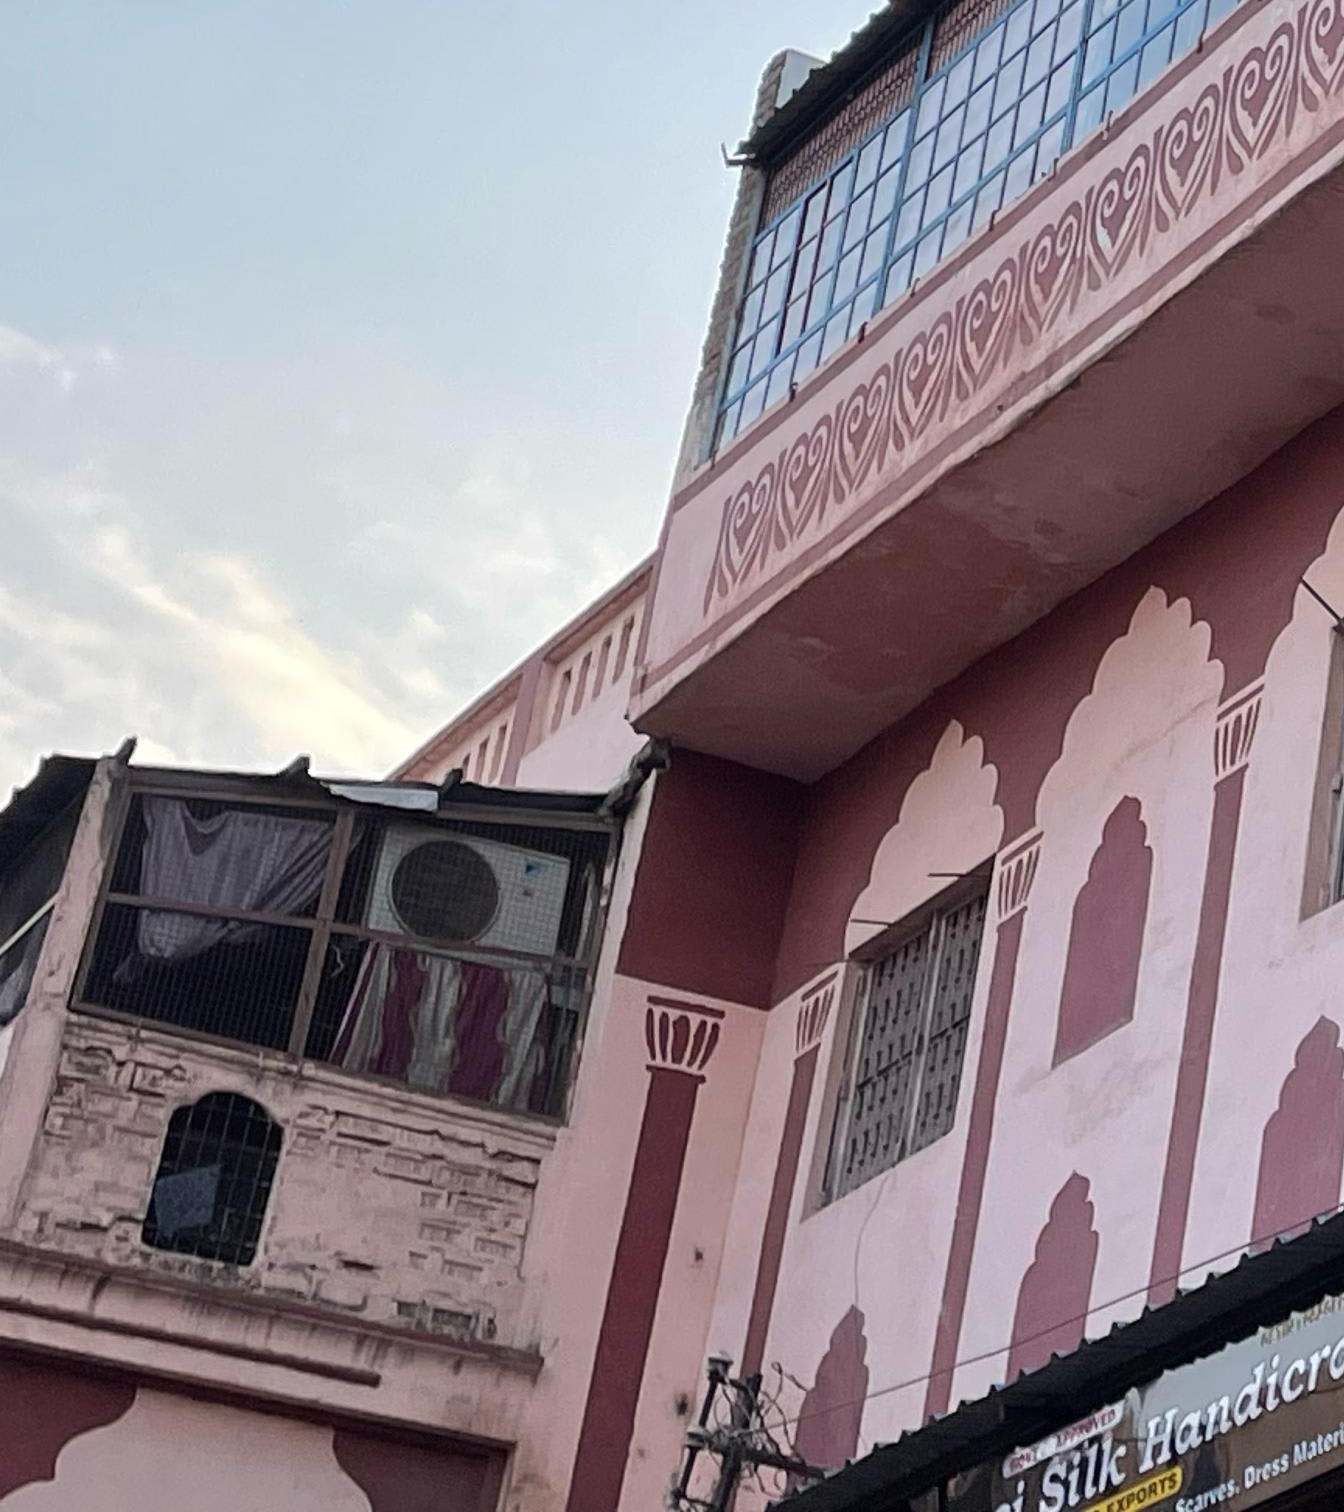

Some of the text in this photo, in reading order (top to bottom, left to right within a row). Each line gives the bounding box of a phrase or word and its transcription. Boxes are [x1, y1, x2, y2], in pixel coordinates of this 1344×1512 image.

[1038, 1431, 1127, 1512] Silk
[1244, 1452, 1289, 1489] Dress
[1106, 1471, 1177, 1512] EXPORTS
